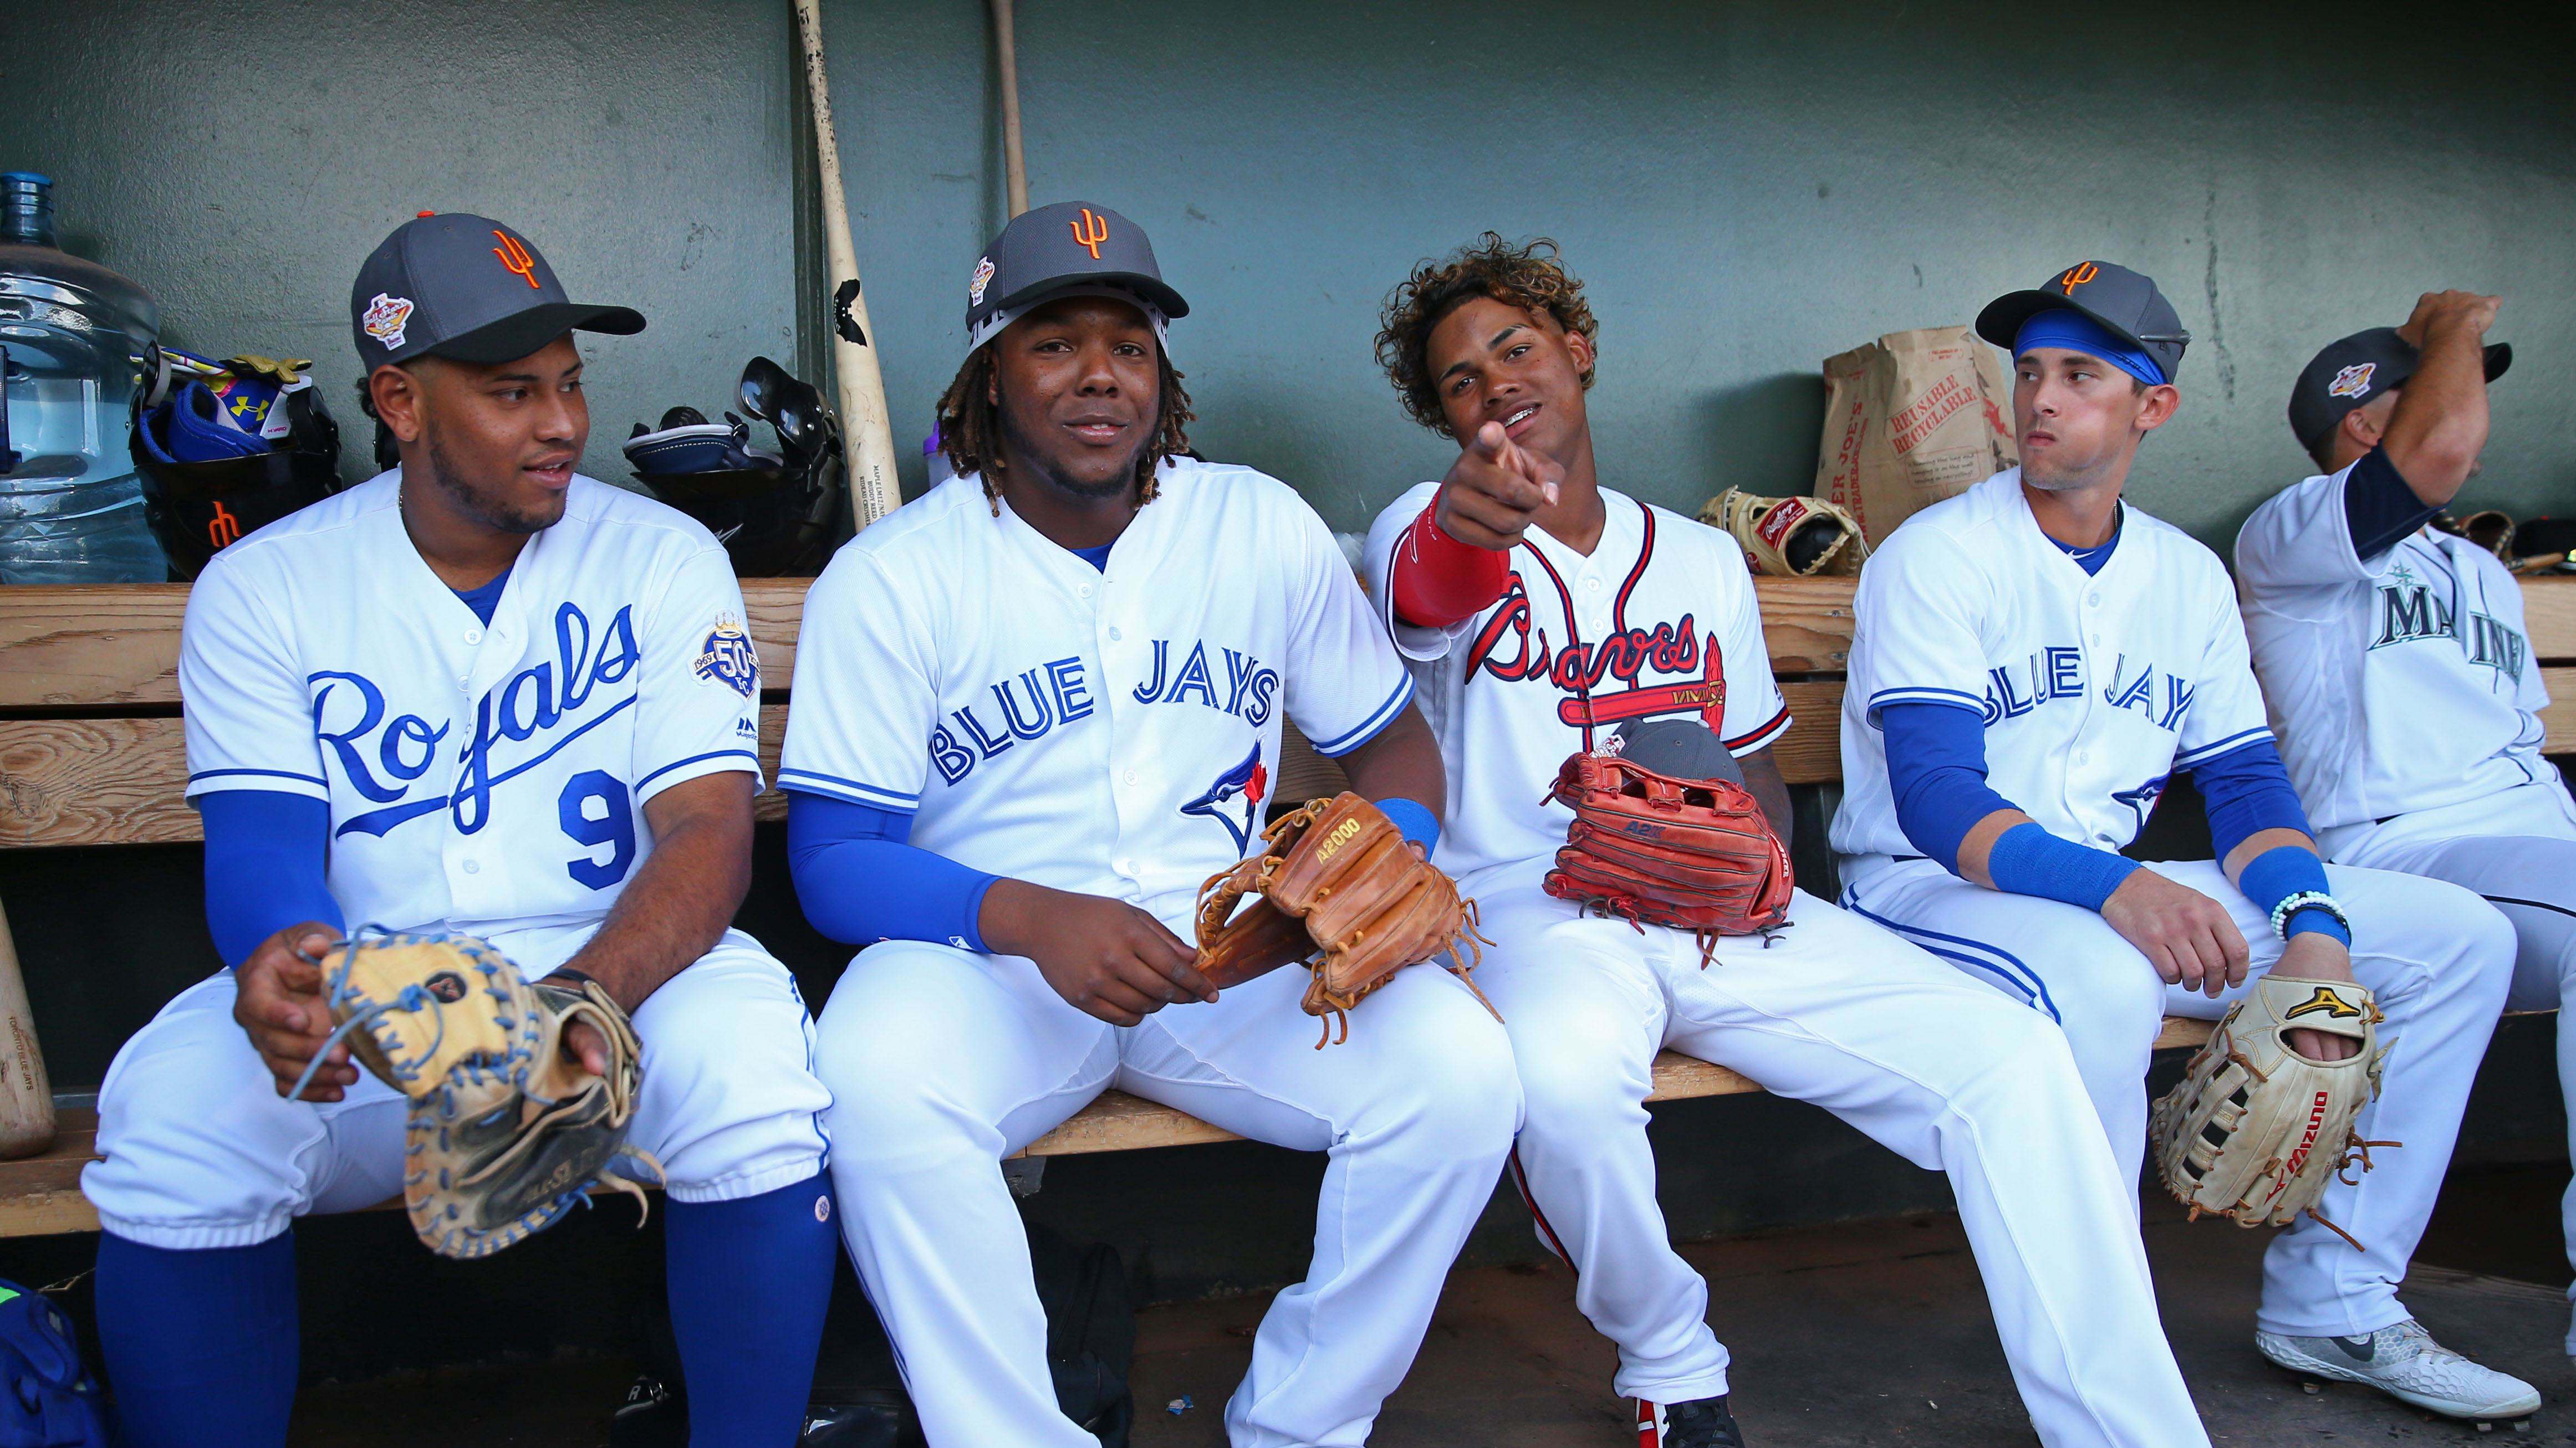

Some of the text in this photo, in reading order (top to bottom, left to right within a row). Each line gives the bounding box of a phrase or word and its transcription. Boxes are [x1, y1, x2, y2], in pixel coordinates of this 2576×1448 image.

[1890, 374, 1960, 433] REUSABLE
[1891, 386, 1978, 454] RECYCLABLE
[859, 476, 868, 498] RIDEAU
[867, 480, 876, 502] BUDDY
[873, 465, 882, 487] MAPLE
[1465, 570, 1645, 686] Braves
[693, 654, 712, 670] 1969
[713, 640, 751, 678] 50
[735, 677, 749, 695] KC
[307, 601, 640, 837] Royals
[929, 638, 1279, 787] BLUE JAYS
[558, 769, 636, 891] 9
[1315, 817, 1361, 866] A2000
[1623, 820, 1666, 839] A2K
